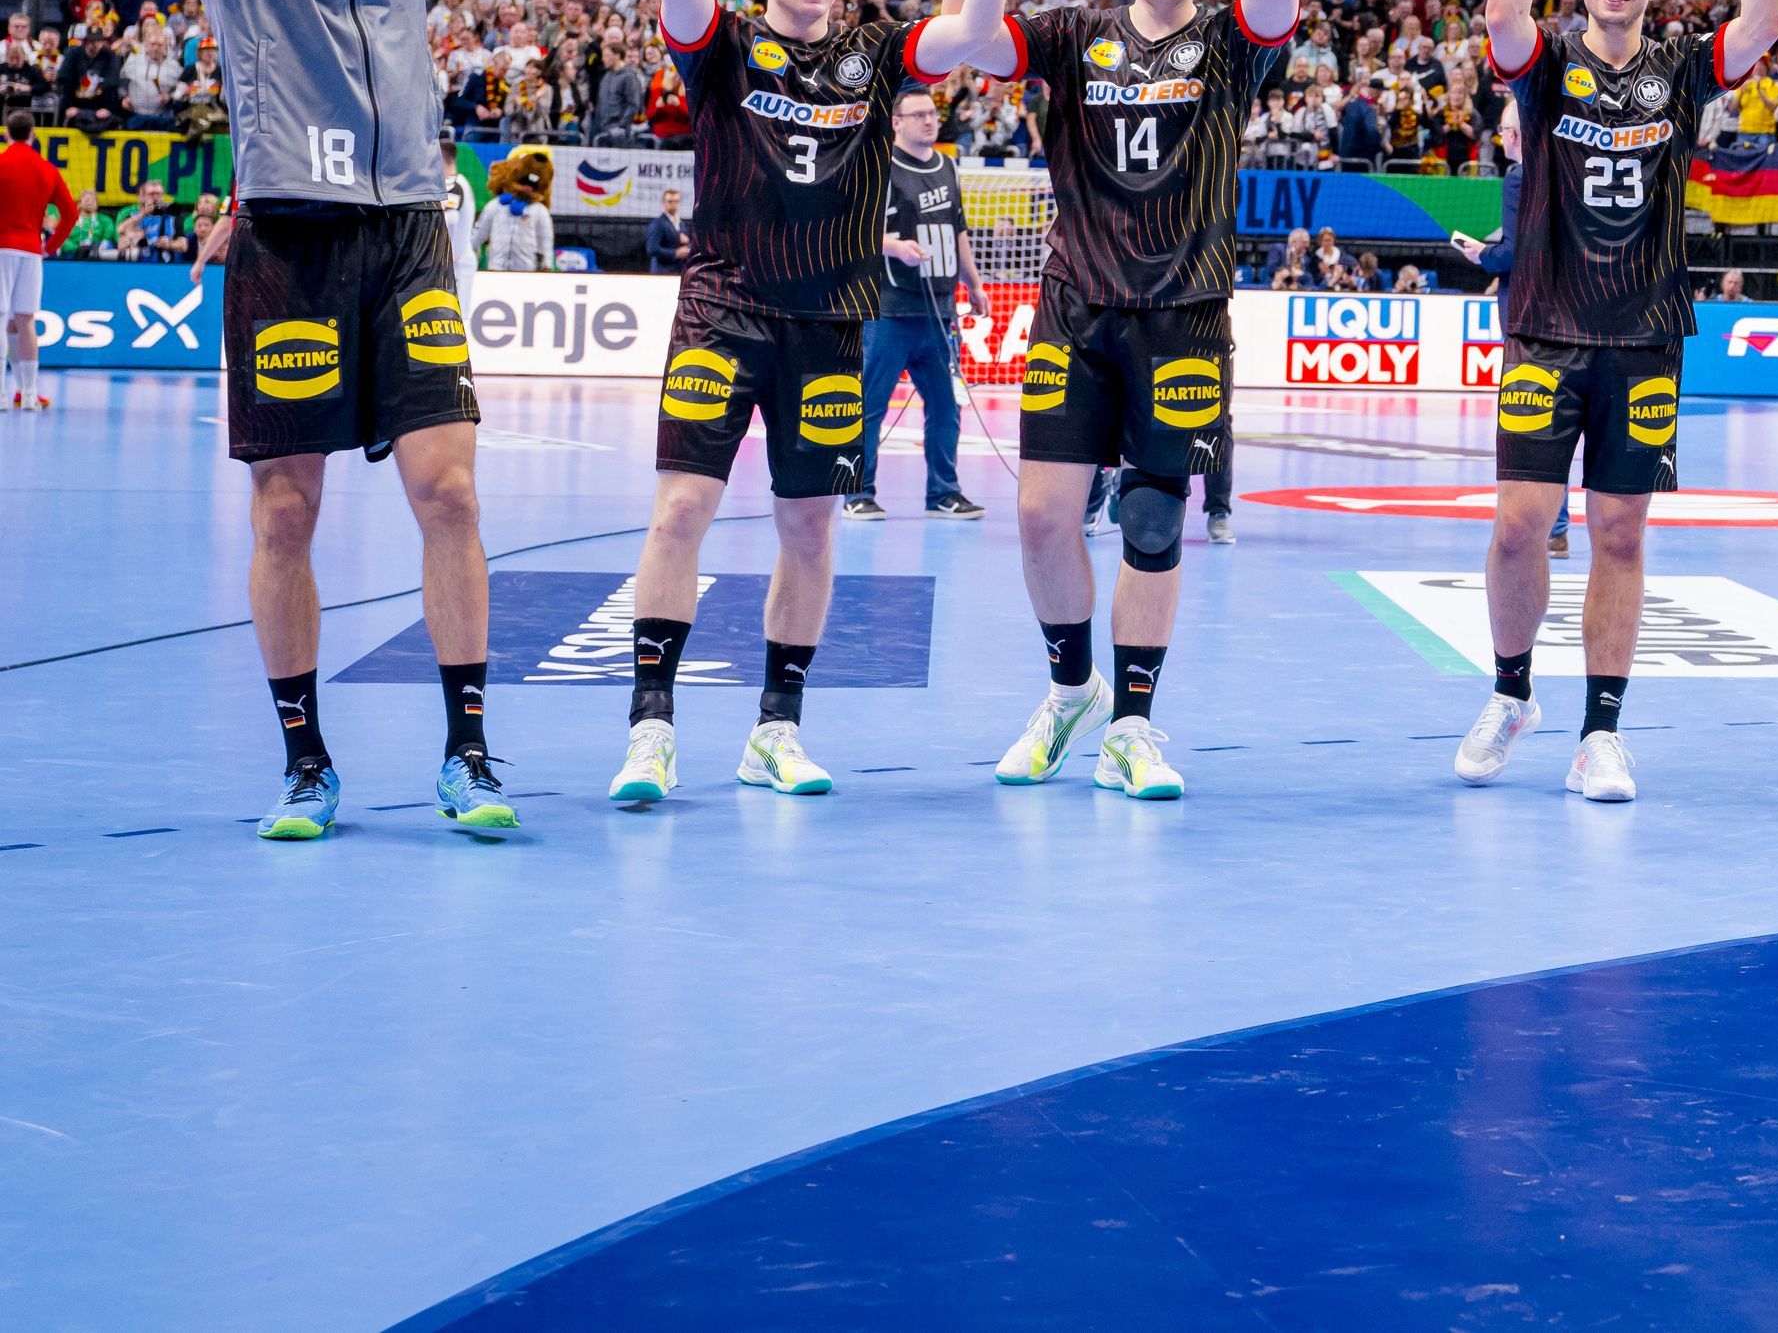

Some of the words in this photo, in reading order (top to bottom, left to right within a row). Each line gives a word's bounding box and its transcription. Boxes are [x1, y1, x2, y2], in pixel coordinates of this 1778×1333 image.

[1087, 81, 1202, 102] AUTOHERO
[1115, 117, 1159, 172] 14
[1558, 118, 1670, 148] AUTOHERO
[90, 139, 149, 195] TO
[307, 126, 356, 186] 18
[786, 134, 819, 184] 3
[1584, 156, 1644, 208] 23
[918, 184, 950, 211] EHF
[1238, 174, 1322, 230] LAY
[404, 320, 465, 340] HARTIN
[1292, 297, 1416, 341] LIQUI
[256, 350, 339, 370] HARTING
[1290, 342, 1418, 383] MOLY
[666, 376, 732, 399] HARTING
[1154, 384, 1220, 401] HARTING
[1500, 391, 1554, 408] HARTING
[801, 401, 862, 418] HARTING
